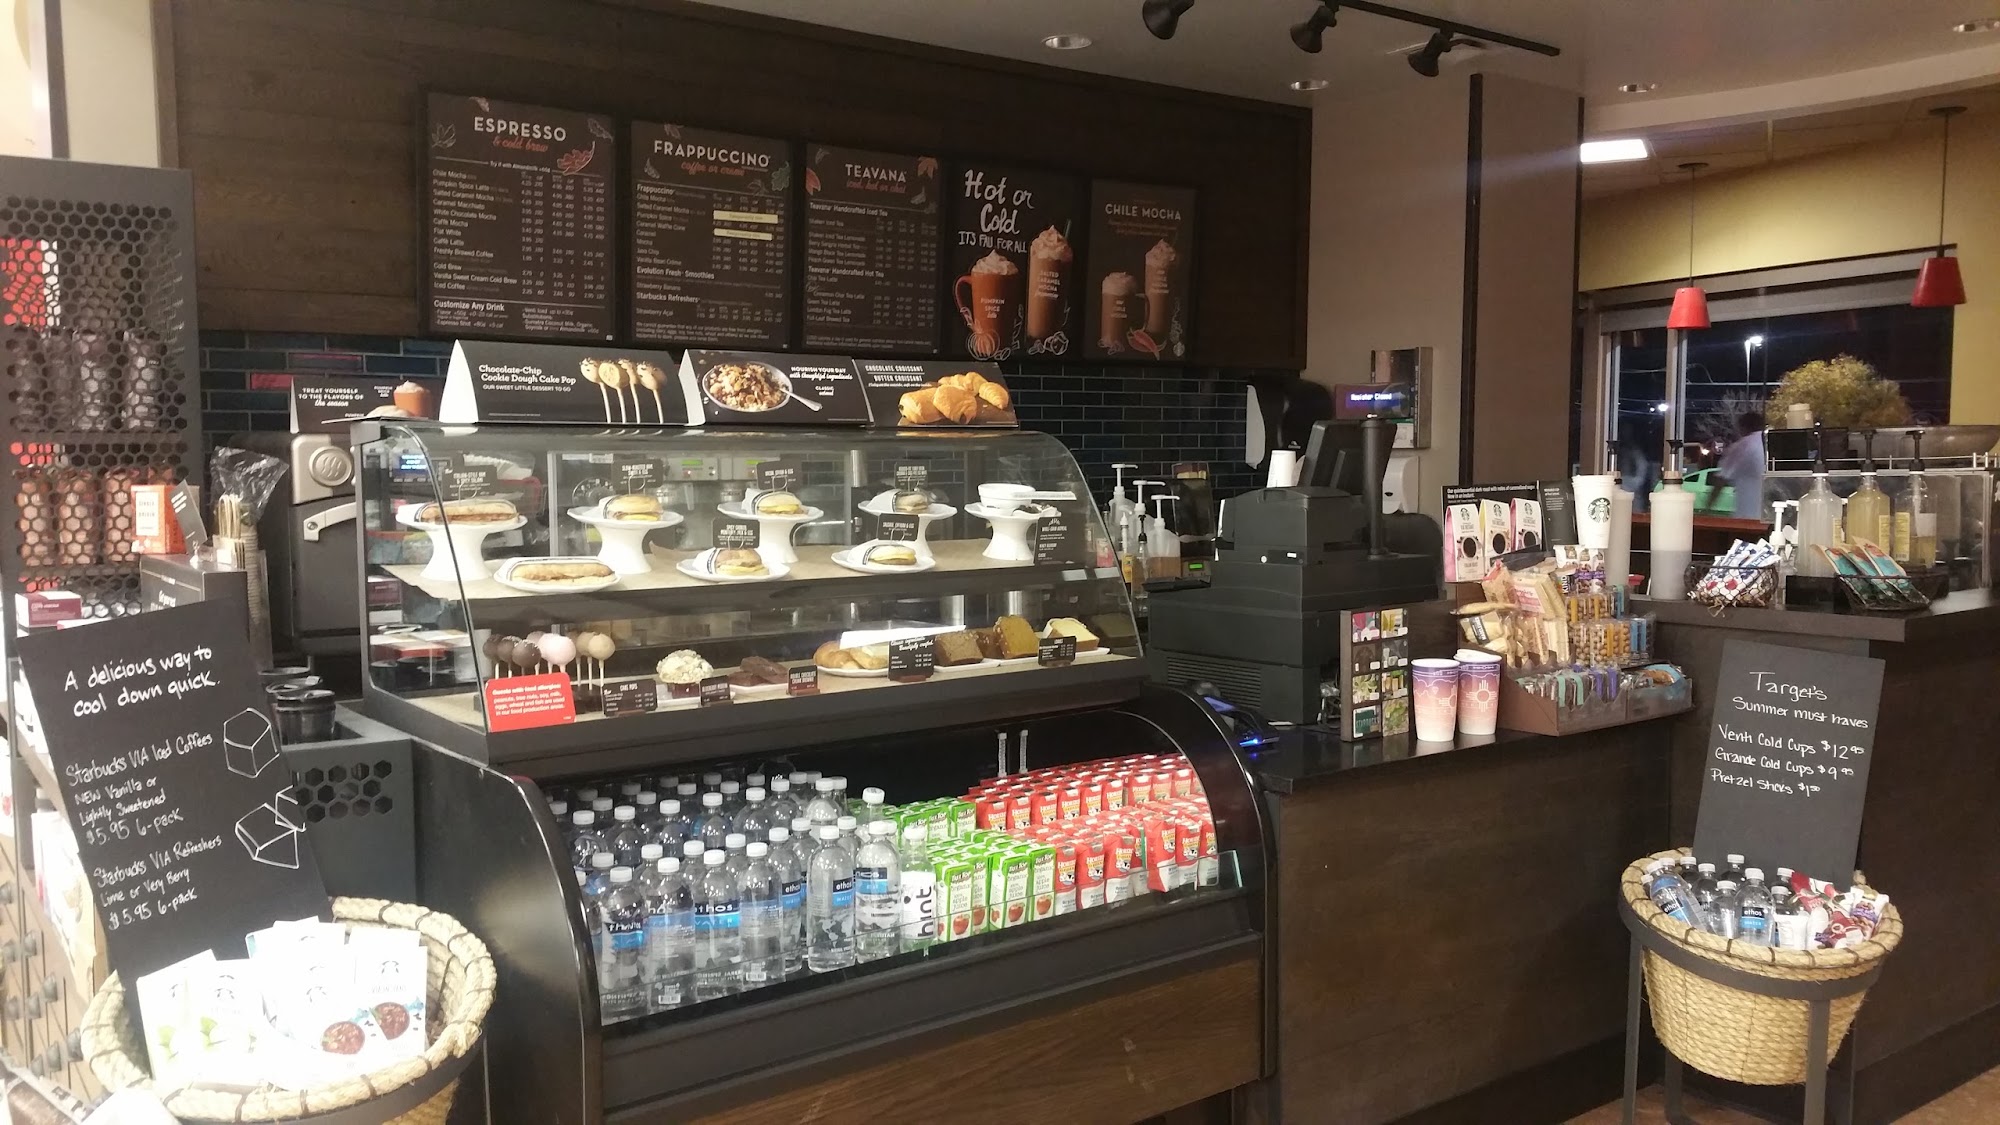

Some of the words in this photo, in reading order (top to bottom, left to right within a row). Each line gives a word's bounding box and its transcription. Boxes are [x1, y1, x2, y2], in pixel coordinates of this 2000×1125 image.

[474, 117, 566, 141] ESPRESSO
[502, 136, 522, 149] cold
[525, 139, 548, 152] brew
[654, 140, 769, 167] FRAPPUCCINO
[681, 162, 706, 175] coffee
[845, 164, 906, 182] TEAVANA
[965, 169, 1007, 204] Hot
[1013, 190, 1035, 209] or
[981, 203, 1020, 234] Cold
[1105, 204, 1137, 216] CHILE
[1142, 208, 1181, 220] MOCHA
[997, 238, 1013, 252] FOR
[1014, 240, 1027, 253] ALL
[434, 300, 470, 309] Customize
[472, 302, 484, 311] Any
[486, 303, 504, 311] Drink
[636, 292, 666, 300] Starbucks
[479, 364, 542, 376] Chocolate-Chip
[481, 373, 509, 381] Cookie
[511, 374, 538, 384] Dough
[539, 375, 559, 383] Cake
[561, 376, 576, 385] Pop
[65, 672, 78, 691] A
[88, 659, 157, 689] delicious
[159, 652, 191, 673] way
[194, 645, 212, 660] to
[73, 693, 107, 717] cool
[117, 684, 163, 707] down
[167, 670, 220, 700] quick.
[1750, 671, 1827, 701] Target's
[1732, 696, 1788, 717] Summer
[1794, 709, 1827, 722] must
[1832, 714, 1868, 728] haves
[66, 757, 127, 787] Starbucks
[129, 747, 149, 769] VIA
[153, 744, 172, 762] Iced
[175, 733, 213, 755] Coffees
[1758, 733, 1782, 749] Cold
[1788, 738, 1816, 758] Cups
[1715, 747, 1756, 766] Grande
[1760, 755, 1780, 770] Cold
[1786, 761, 1814, 778] Cups
[74, 789, 100, 806] NEW
[106, 778, 142, 799] Vanilla
[146, 776, 158, 787] or
[1711, 768, 1752, 788] Pretzel
[1757, 779, 1793, 794] Sticks
[79, 803, 112, 827] Lightly
[117, 789, 166, 817] Sweetened
[85, 819, 130, 846] $5.95
[137, 808, 184, 836] 6-pack
[93, 858, 147, 888] Starbucks
[150, 849, 171, 870] VIA
[173, 835, 222, 859] Refreshers
[100, 890, 125, 908] Lime
[129, 886, 141, 897] or
[143, 875, 165, 900] Very
[166, 867, 190, 888] Berry
[108, 901, 151, 931] $5.95
[157, 888, 197, 915] 6-pack
[916, 886, 934, 937] hint
[1743, 909, 1763, 918] ethos
